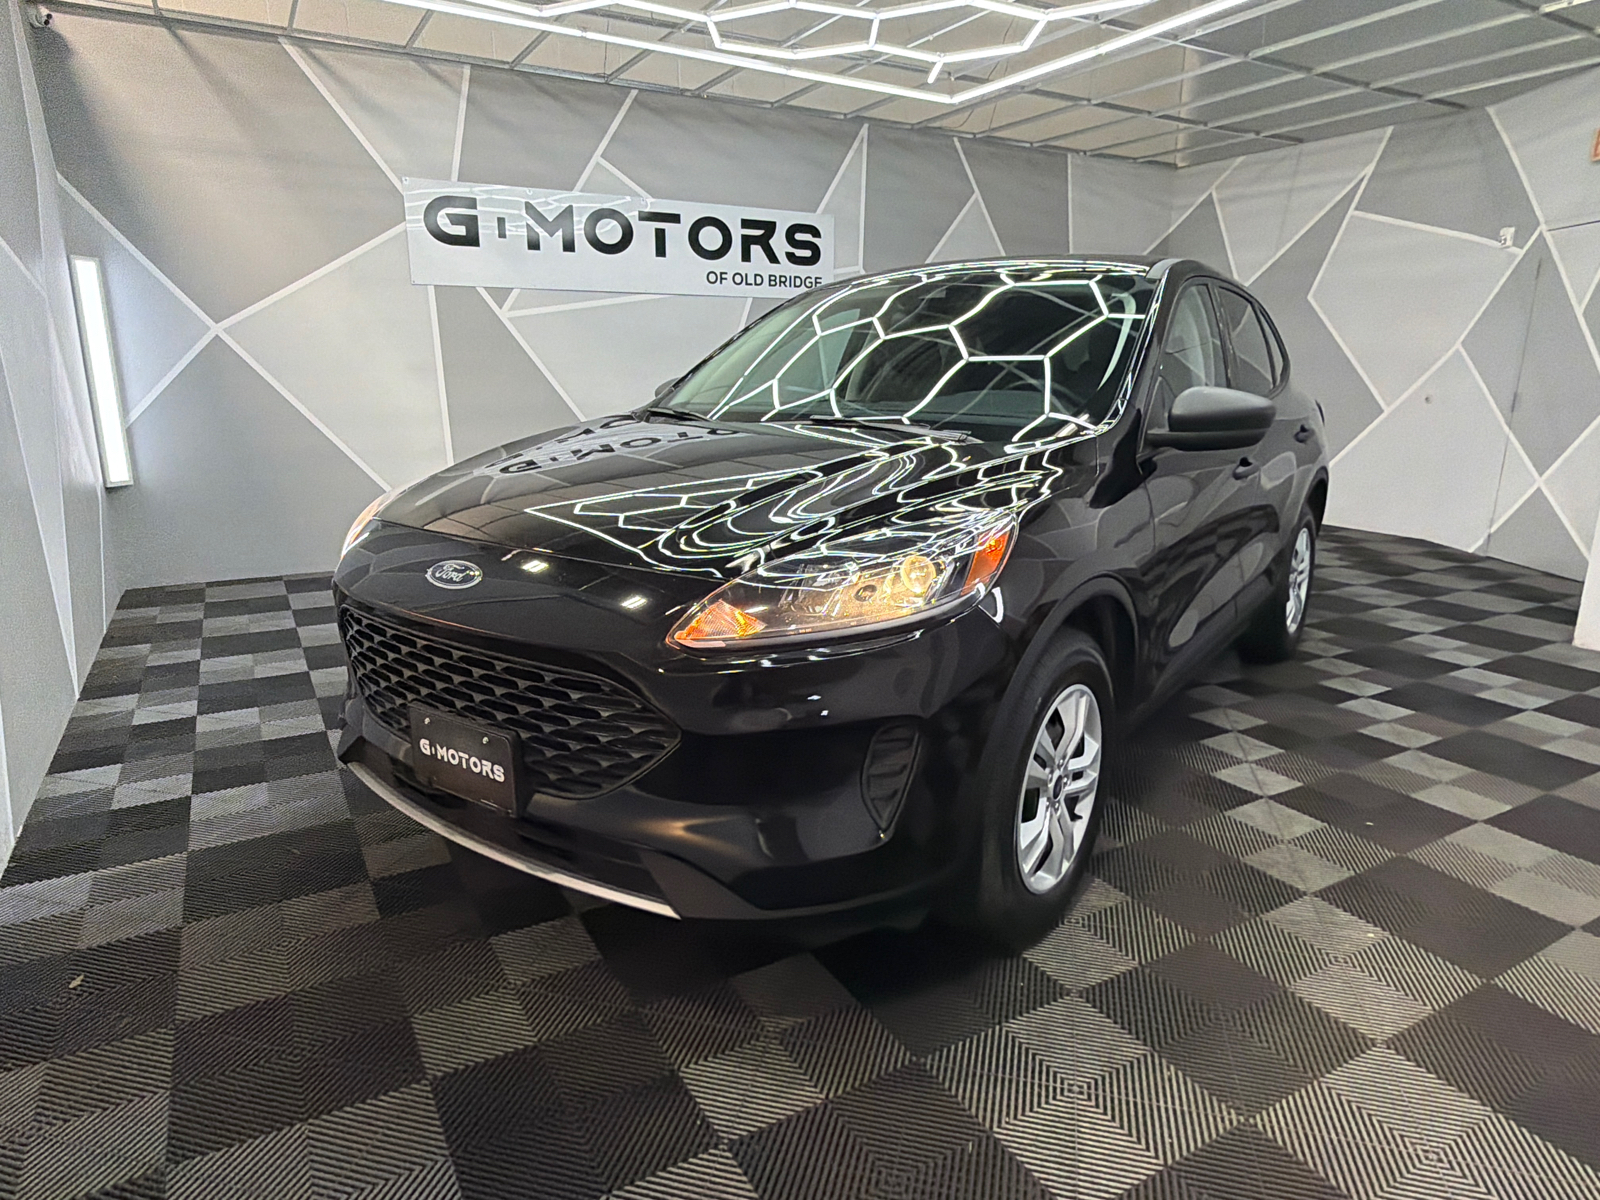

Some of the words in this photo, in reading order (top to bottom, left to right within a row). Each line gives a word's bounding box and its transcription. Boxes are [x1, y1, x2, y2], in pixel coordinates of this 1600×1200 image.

[706, 271, 728, 285] OF
[732, 272, 764, 286] OLD
[435, 563, 469, 582] Ford
